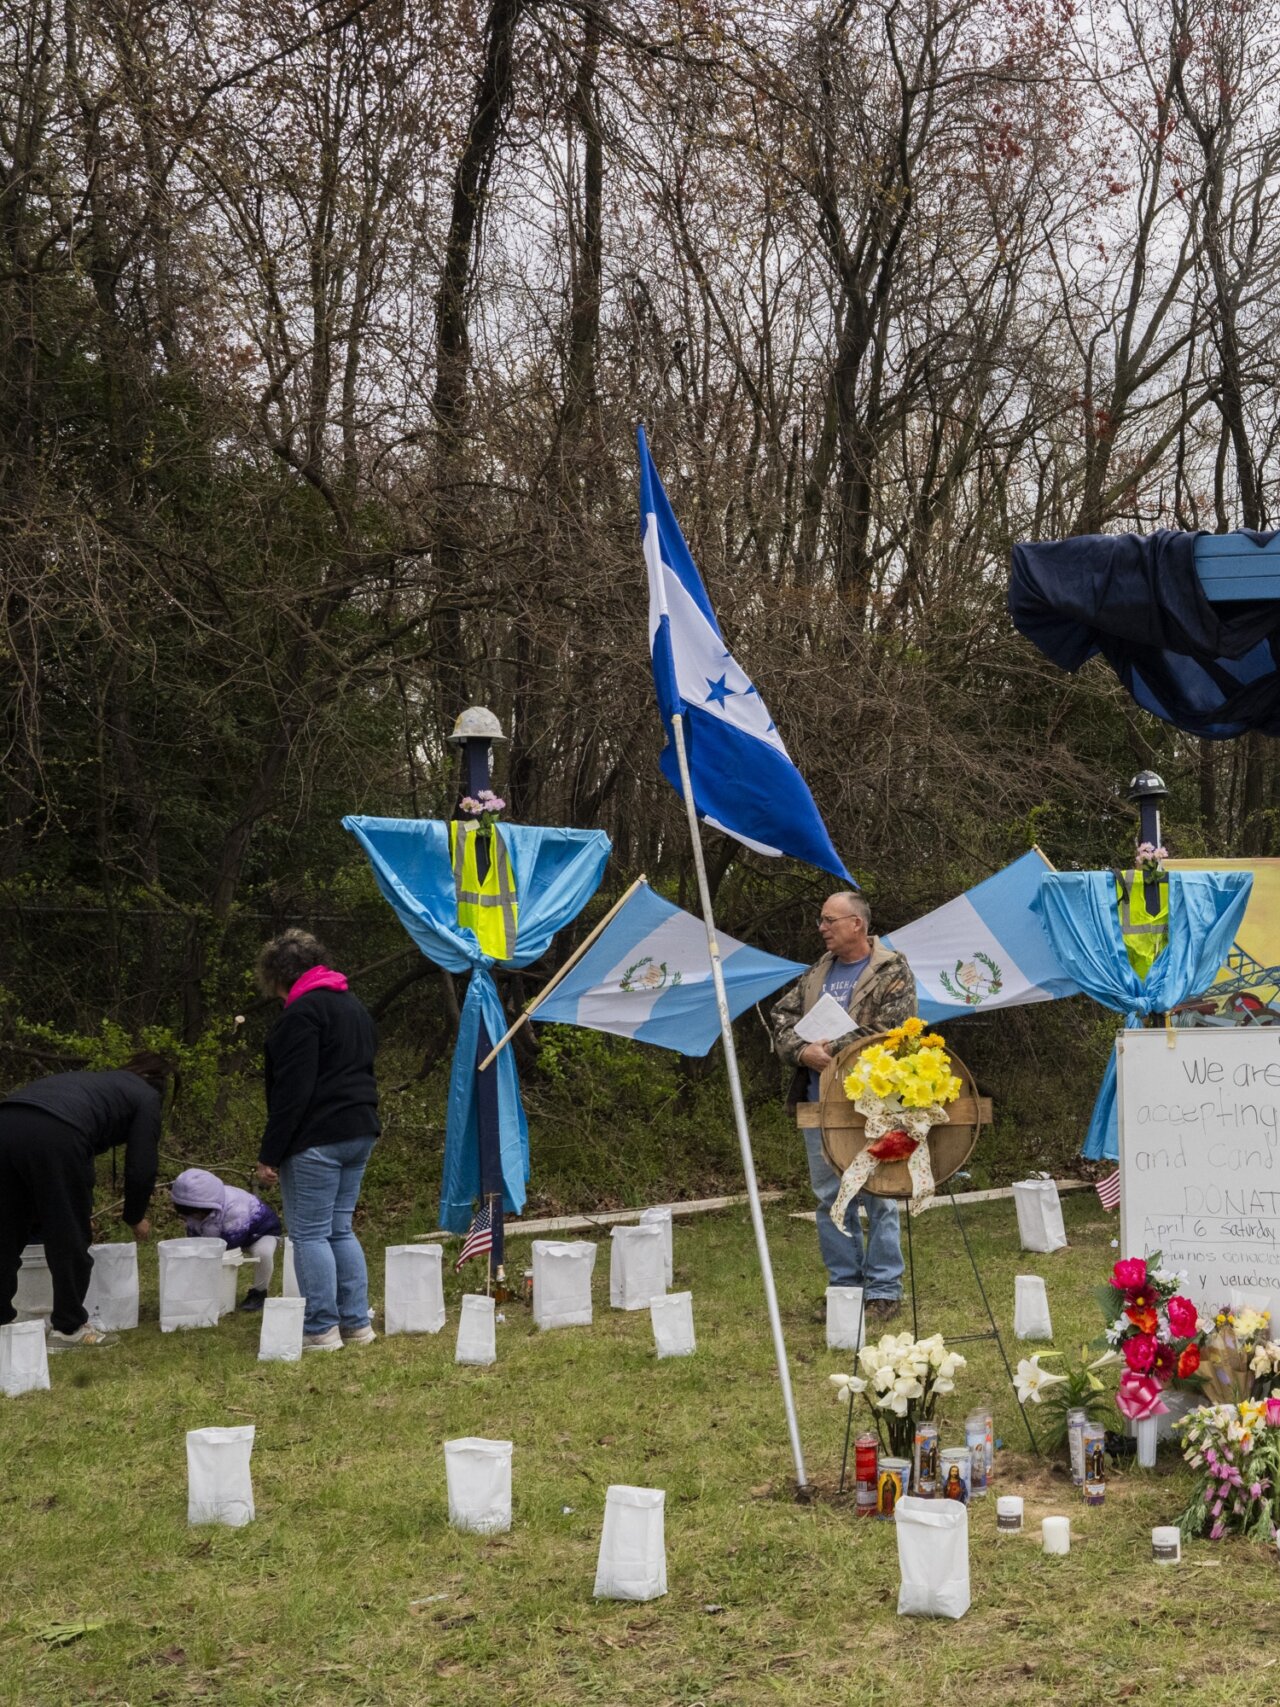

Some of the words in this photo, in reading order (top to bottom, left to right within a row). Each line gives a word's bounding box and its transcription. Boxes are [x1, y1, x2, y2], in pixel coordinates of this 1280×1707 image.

[1182, 1057, 1225, 1085] We
[1136, 1087, 1279, 1146] accepting
[1135, 1133, 1188, 1172] and
[1143, 1215, 1185, 1244] April
[1193, 1219, 1207, 1237] 6
[1220, 1217, 1276, 1250] Saturday
